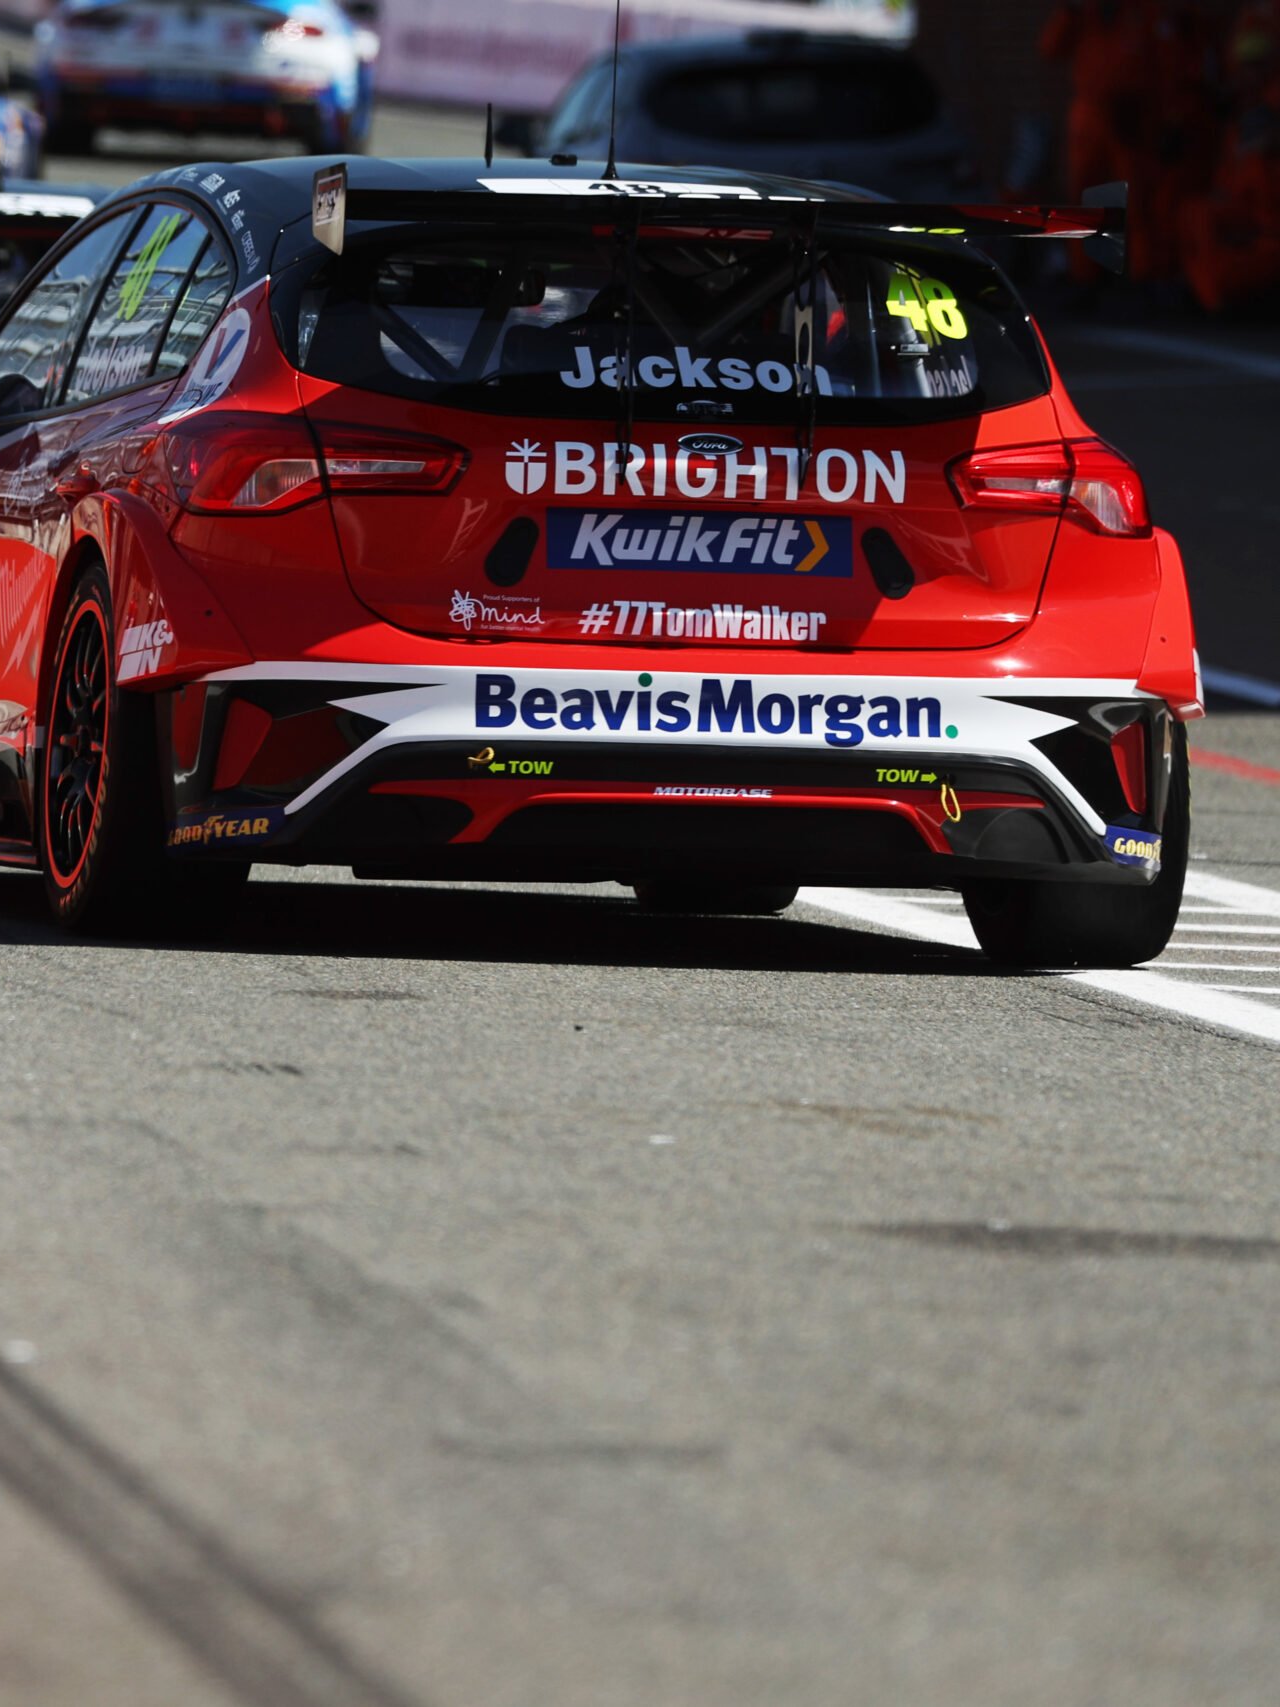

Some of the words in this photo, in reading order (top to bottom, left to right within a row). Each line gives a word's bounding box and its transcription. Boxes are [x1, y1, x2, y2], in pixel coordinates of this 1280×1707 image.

[886, 271, 968, 340] 48
[559, 346, 833, 397] Jackson
[554, 440, 906, 504] BRIGHTON
[480, 606, 546, 625] mind
[578, 600, 827, 641] #77TomWalker
[507, 760, 554, 775] TOW
[875, 768, 920, 783] TOW
[652, 786, 774, 799] MOTORBASE
